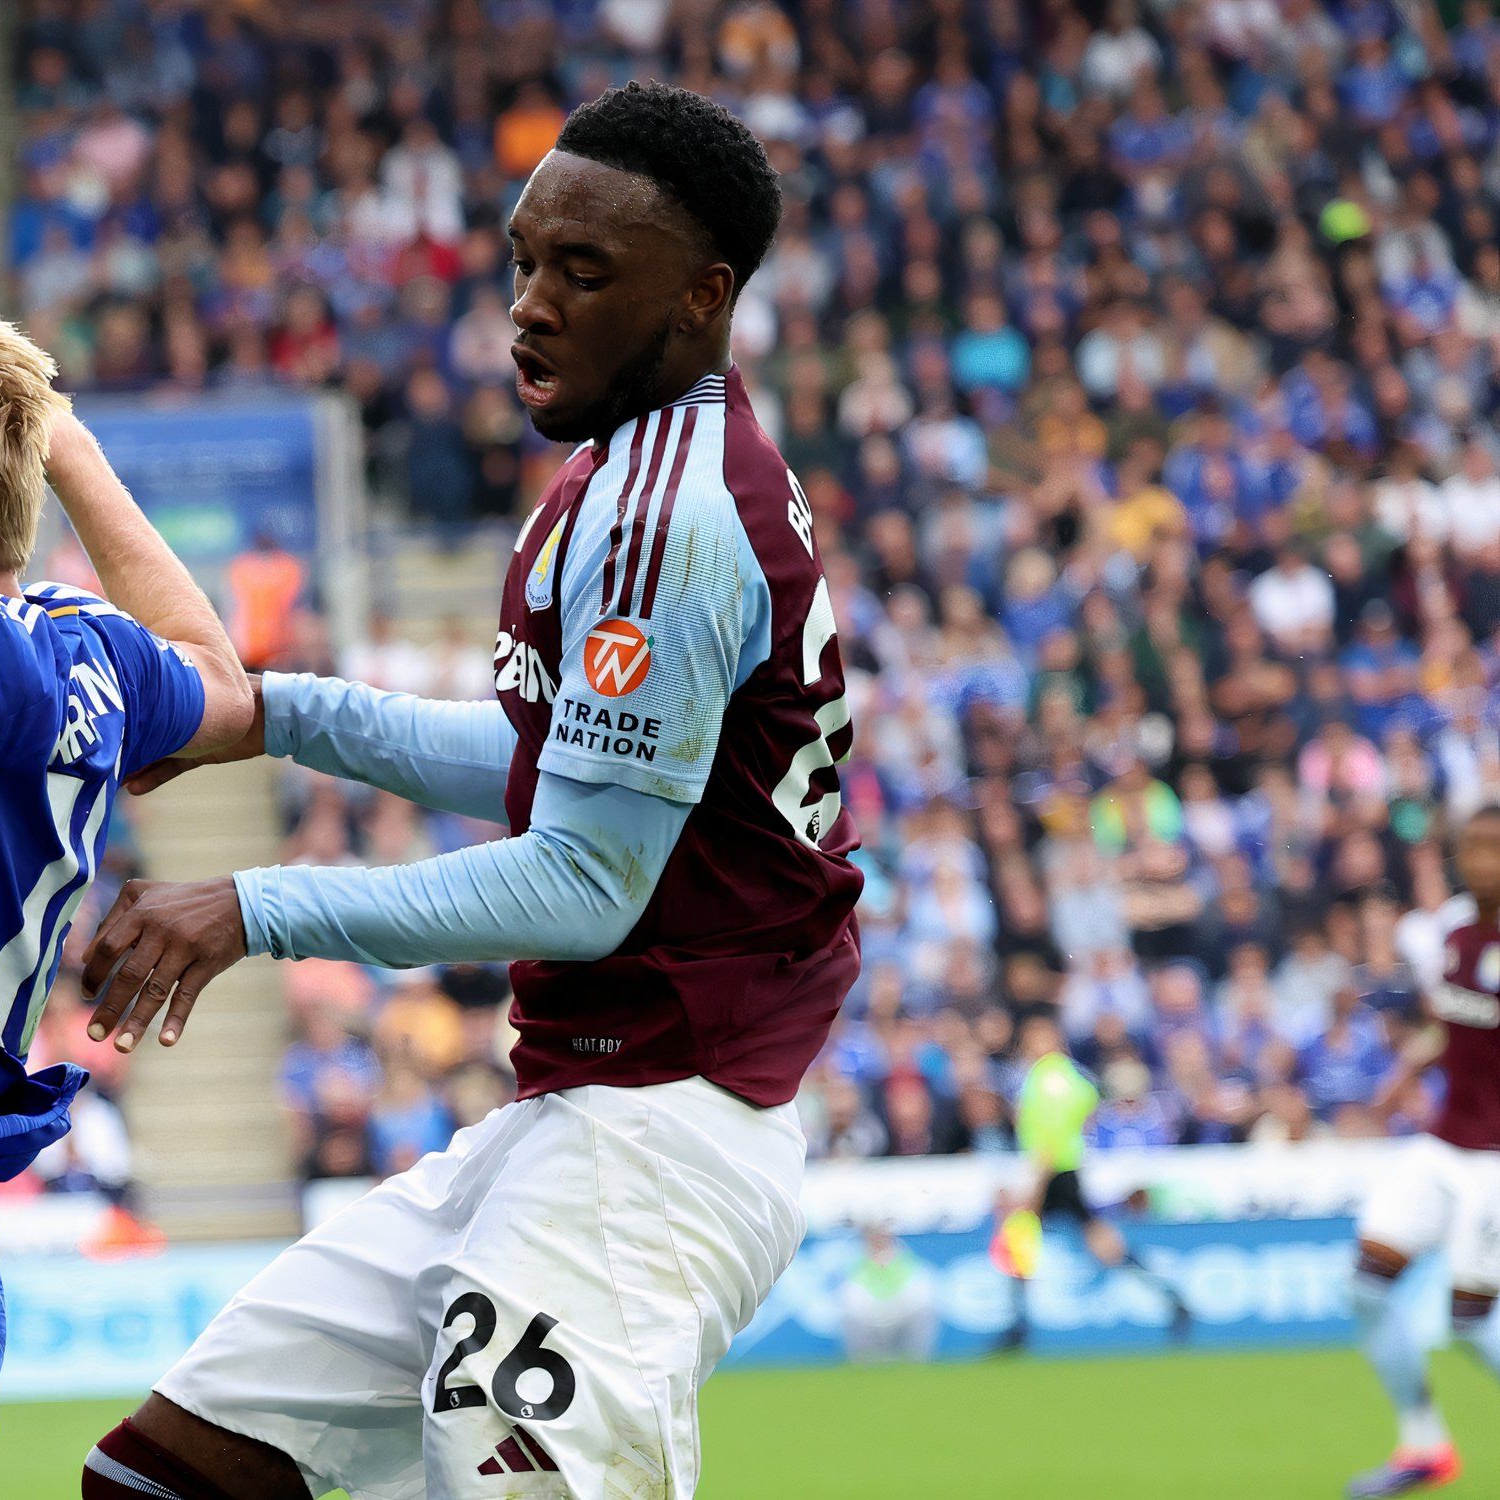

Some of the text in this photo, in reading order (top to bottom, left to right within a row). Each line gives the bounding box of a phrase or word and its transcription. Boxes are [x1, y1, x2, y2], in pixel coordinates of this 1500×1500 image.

[563, 697, 663, 740] TRADE
[555, 724, 658, 763] NATION
[432, 1291, 576, 1422] 26
